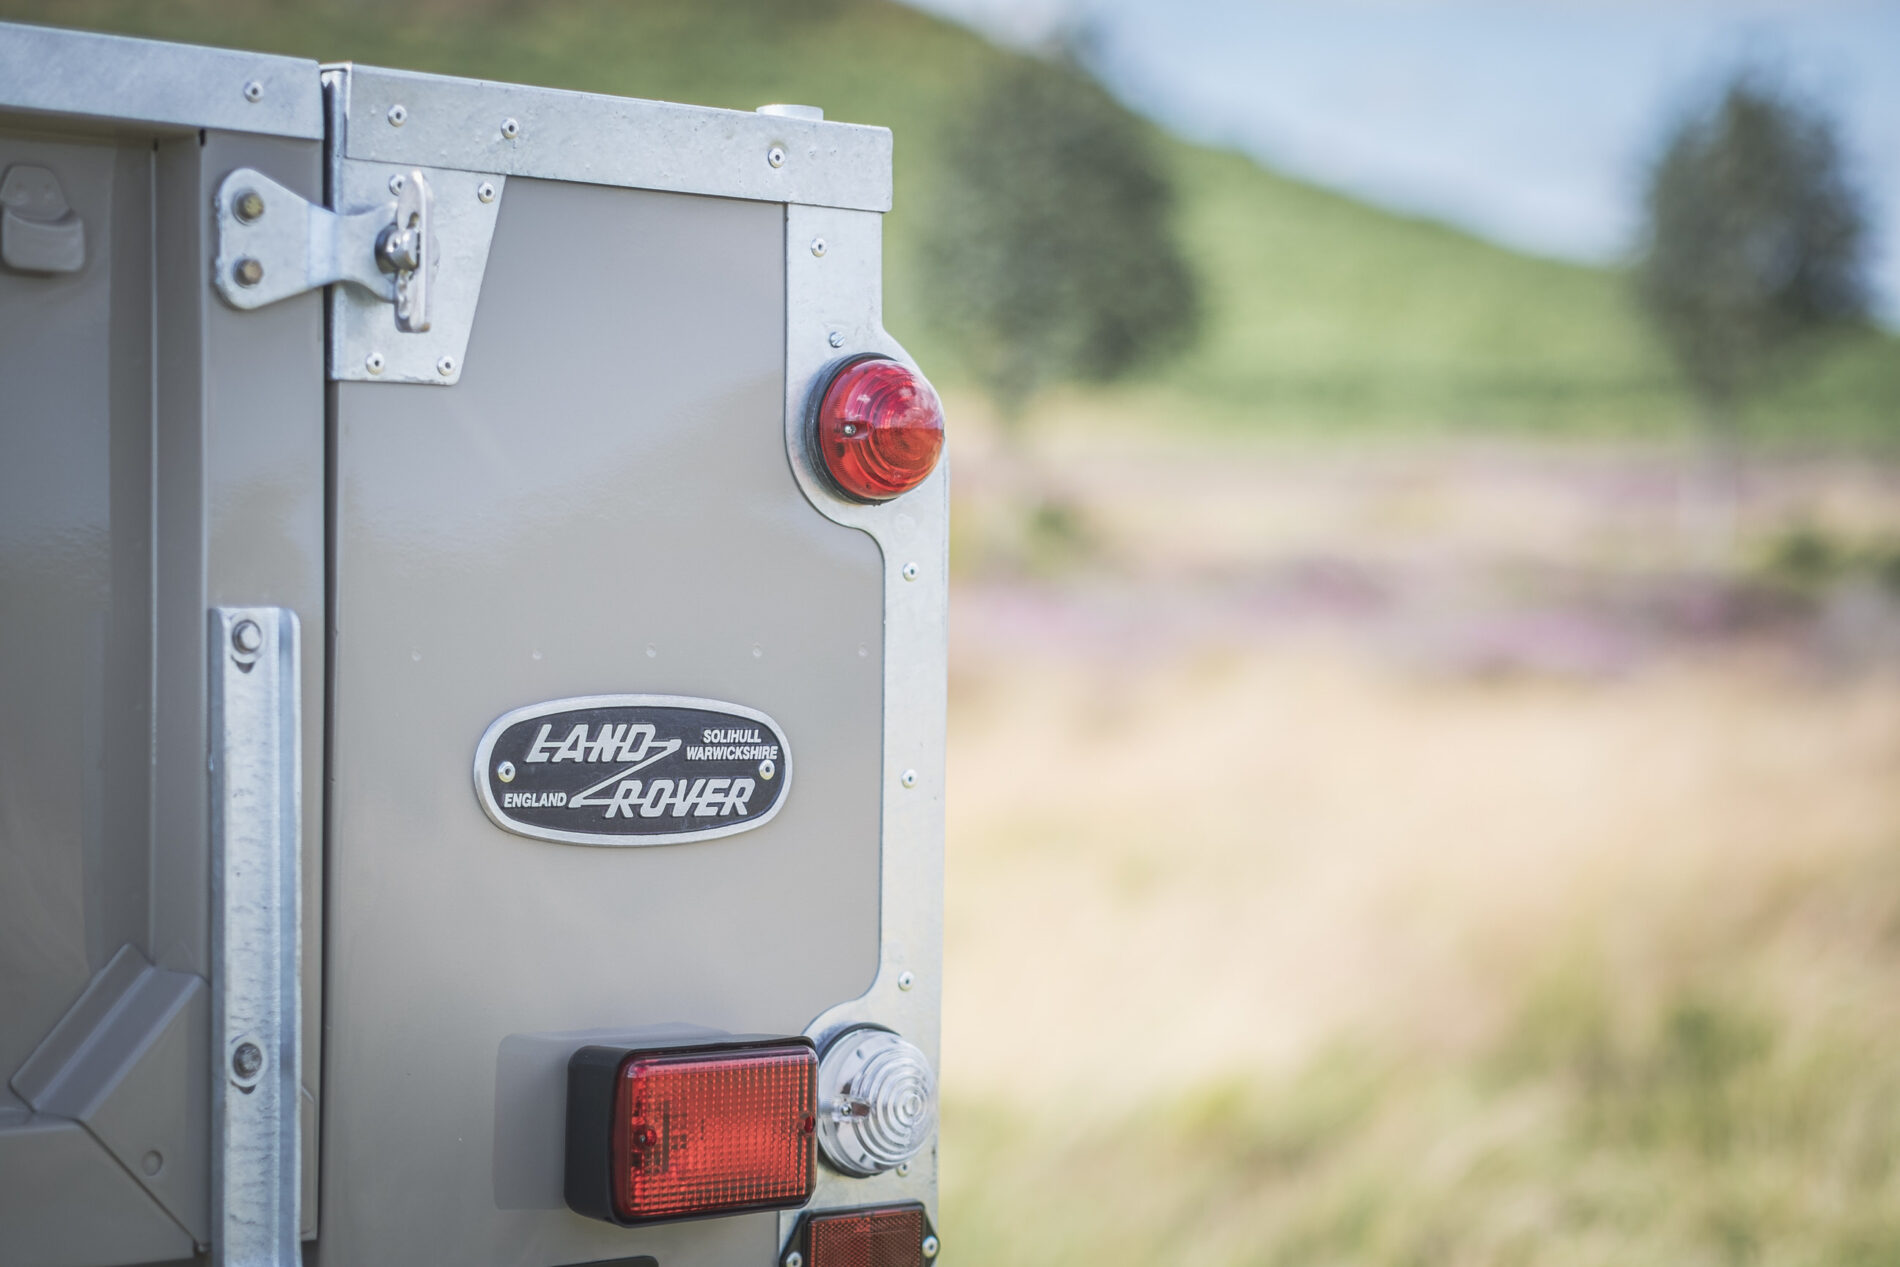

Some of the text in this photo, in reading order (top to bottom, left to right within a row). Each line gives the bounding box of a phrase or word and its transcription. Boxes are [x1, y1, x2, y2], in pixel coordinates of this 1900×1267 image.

[526, 723, 656, 763] LAND
[702, 729, 762, 744] SOLIHULL
[686, 746, 779, 760] WARWICKSHIRE
[503, 792, 567, 808] ENGLAND
[604, 778, 756, 818] ROVER
